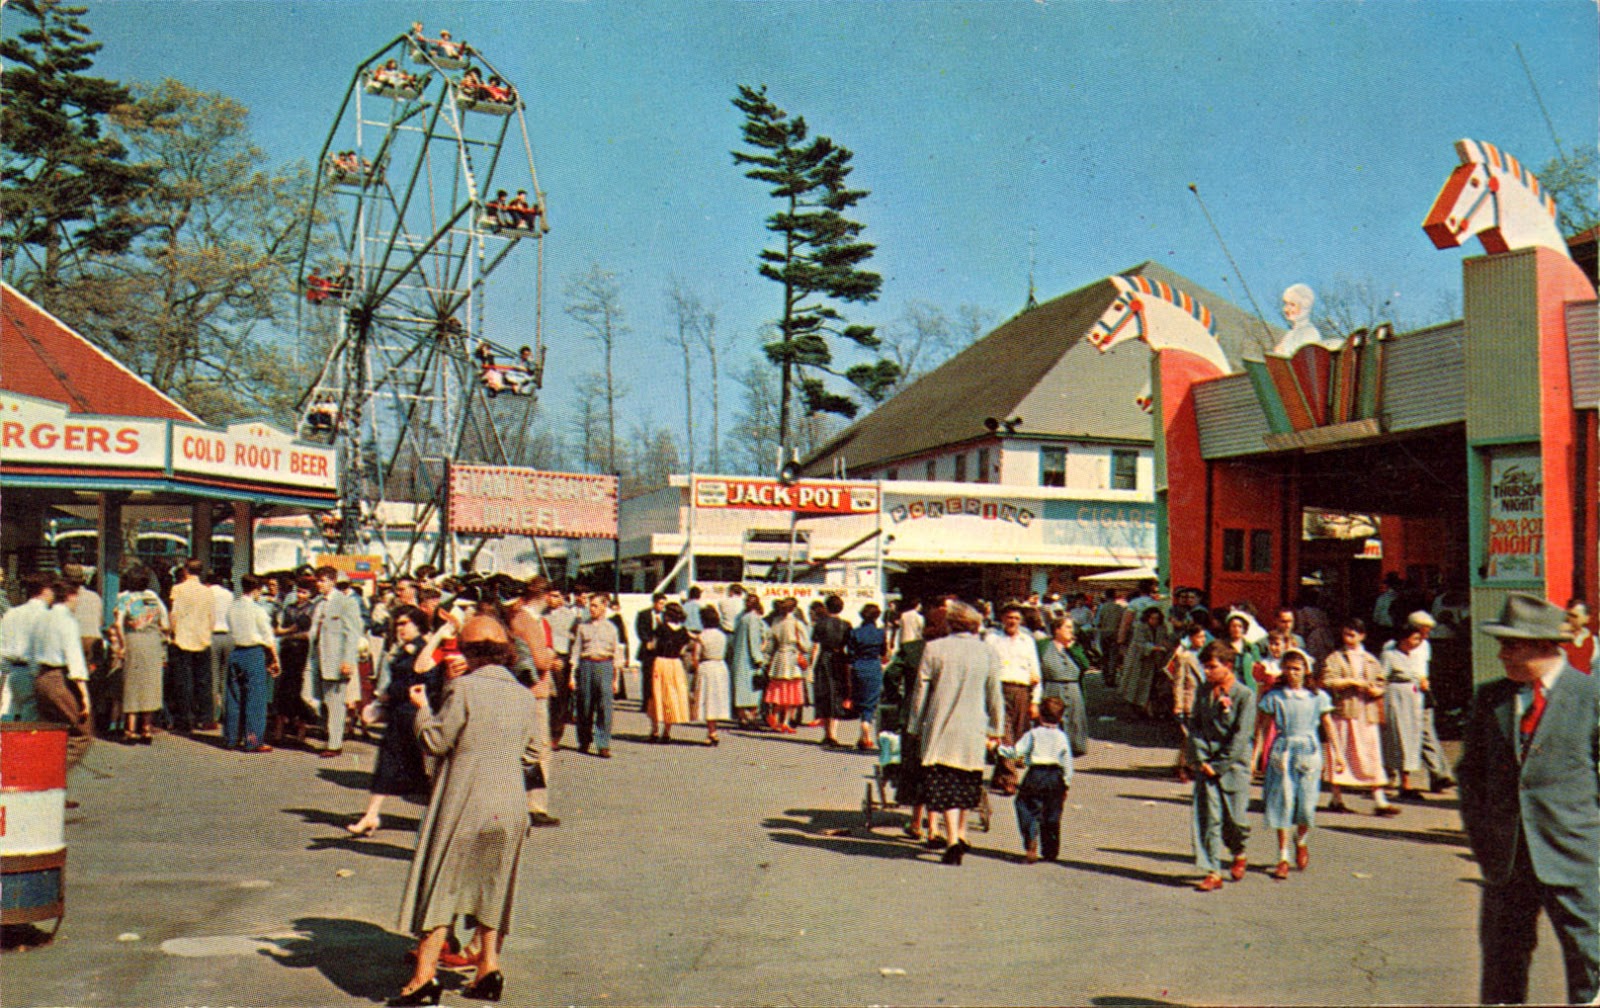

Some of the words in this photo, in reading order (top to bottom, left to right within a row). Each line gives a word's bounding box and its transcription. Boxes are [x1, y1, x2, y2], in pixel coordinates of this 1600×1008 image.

[1, 420, 140, 455] RGERS
[183, 435, 226, 464] COLD
[235, 443, 282, 471] ROOT
[290, 452, 329, 478] BEER
[1489, 534, 1543, 555] NIGHT
[764, 587, 790, 597] JACK
